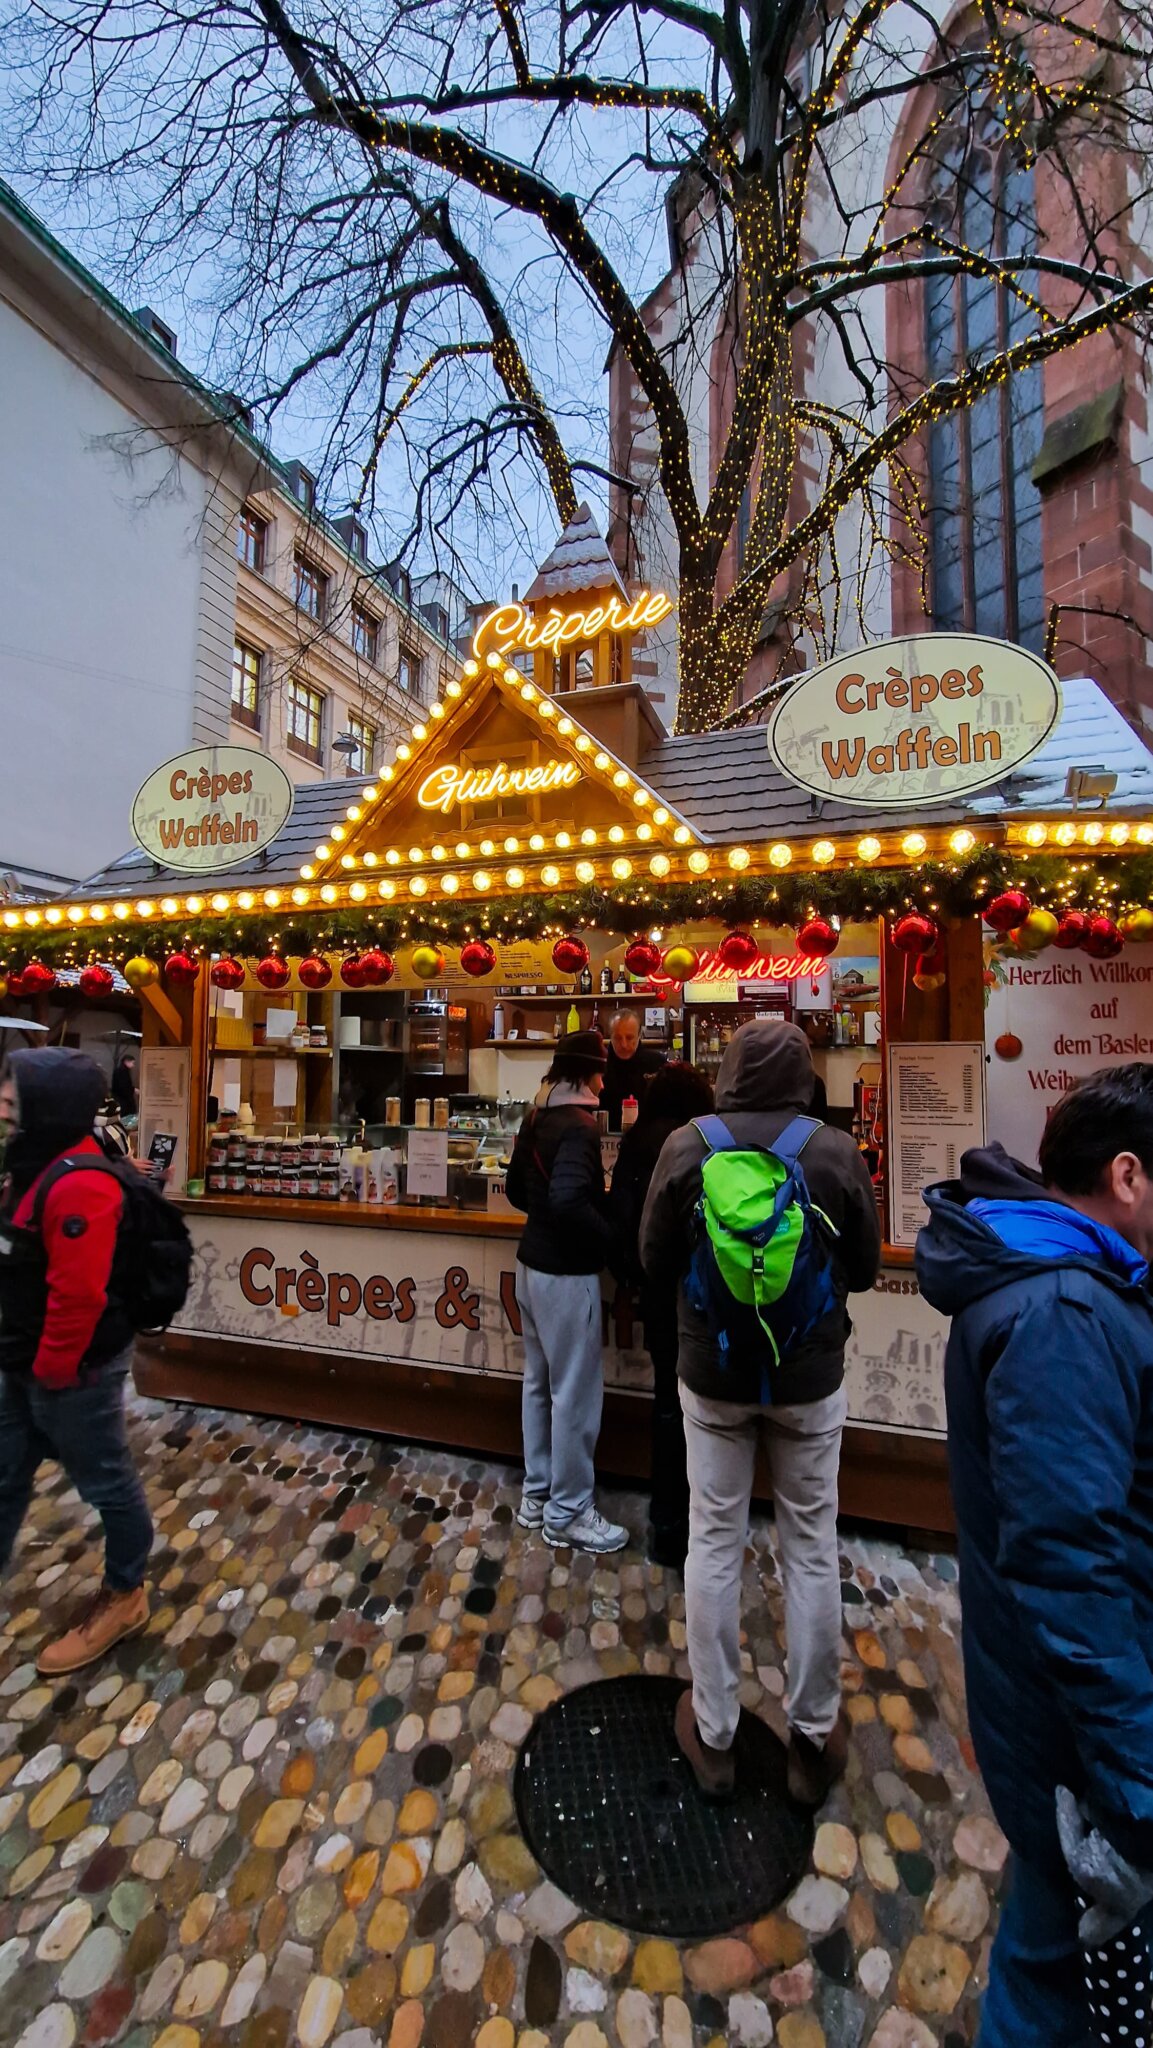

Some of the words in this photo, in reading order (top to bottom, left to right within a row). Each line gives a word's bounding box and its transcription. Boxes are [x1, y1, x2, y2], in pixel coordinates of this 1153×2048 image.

[836, 665, 983, 714] Crèpes
[822, 722, 1001, 780] Waffeln
[169, 767, 253, 802] Crèpes
[417, 760, 581, 814] Glühwein
[159, 812, 258, 849] Waffeln
[1009, 964, 1082, 985] Herzlich
[1090, 997, 1118, 1019] auf
[1054, 1034, 1091, 1055] dem
[1028, 1069, 1073, 1091] Weih
[239, 1247, 416, 1327] Crèpes
[435, 1266, 480, 1331] &
[873, 1273, 919, 1295] Gass
